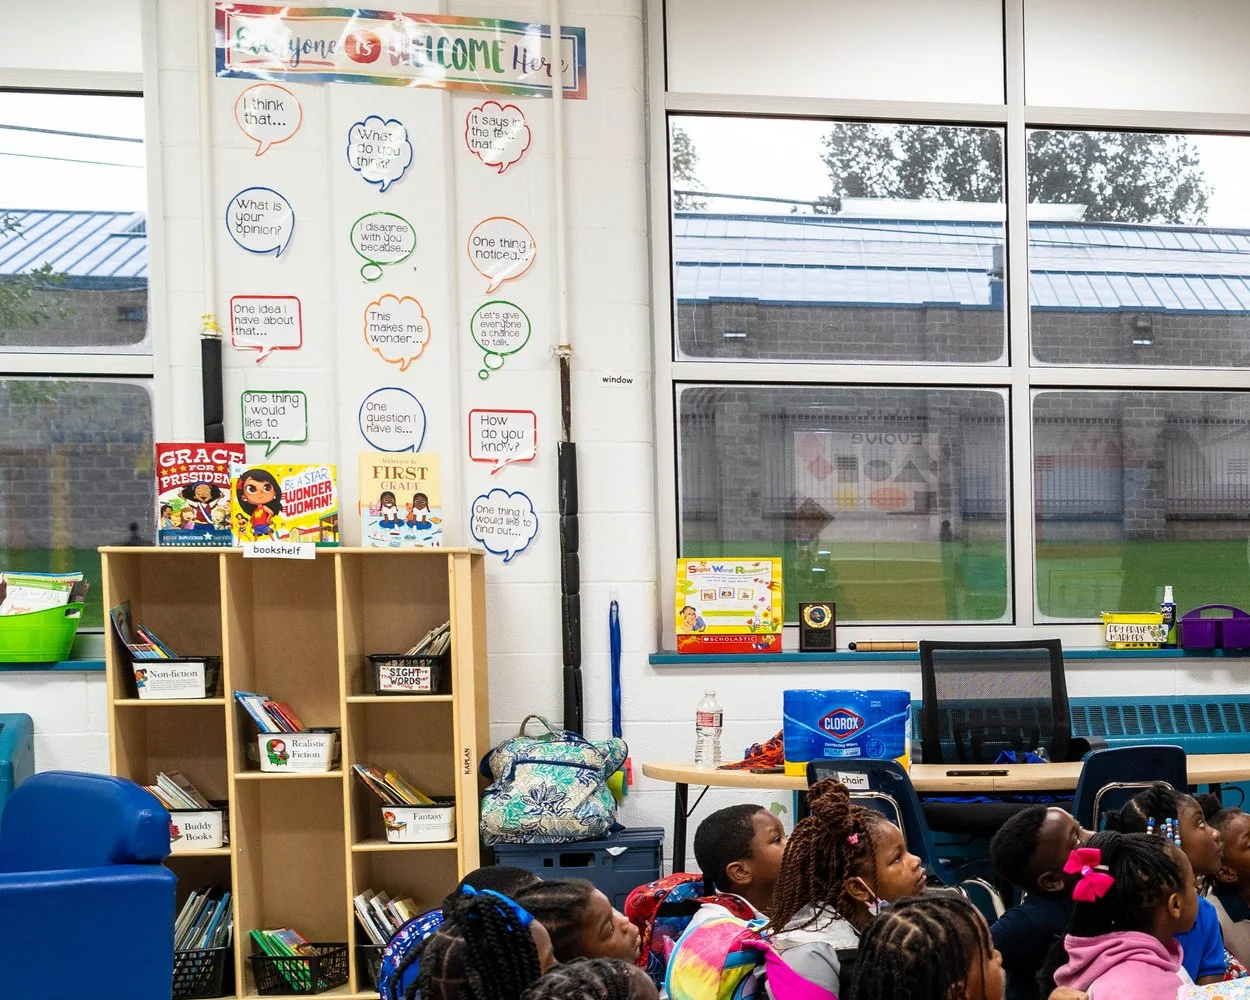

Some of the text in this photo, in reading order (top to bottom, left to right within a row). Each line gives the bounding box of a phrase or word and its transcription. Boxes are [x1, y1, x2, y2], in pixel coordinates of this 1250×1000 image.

[252, 98, 284, 111] think
[472, 114, 509, 129] It says
[358, 129, 392, 142] What
[472, 127, 489, 137] the
[357, 144, 400, 157] do you
[237, 199, 282, 211] What is
[236, 212, 264, 225] your
[236, 224, 281, 238] opinion?
[366, 223, 408, 235] disagree
[361, 233, 402, 246] with you
[473, 236, 526, 253] One thing
[234, 304, 281, 313] One idea
[235, 316, 293, 324] have about
[370, 312, 390, 321] This
[503, 312, 519, 322] give
[370, 324, 404, 332] makes
[481, 321, 521, 331] everyone
[236, 327, 267, 336] that...
[371, 334, 422, 343] wonder...
[602, 375, 633, 384] window
[244, 393, 299, 408] One thing
[251, 405, 285, 415] would
[366, 402, 387, 411] One
[245, 418, 278, 427] like to
[366, 414, 410, 425] question
[481, 415, 508, 425] How
[366, 424, 391, 433] have
[246, 429, 279, 439] add...
[482, 429, 524, 444] do you
[482, 442, 520, 452] know?
[160, 448, 244, 467] GRACE
[372, 466, 428, 480] FIRST
[161, 471, 231, 487] PRESIDEN
[285, 469, 329, 490] BE A STAR
[381, 482, 420, 490] GRADE
[285, 481, 332, 504] WONDER
[285, 494, 333, 516] WOMAN!
[476, 505, 519, 520] One thing
[476, 516, 503, 525] would
[506, 518, 520, 526] like
[476, 526, 494, 534] find
[254, 546, 301, 555] bookshelf
[712, 565, 733, 573] Word
[736, 566, 769, 574] Readers
[1109, 625, 1123, 633] DRY
[150, 669, 198, 679] Non-fiction
[390, 668, 420, 676] SIGHT
[825, 718, 859, 729] CLOROX
[292, 740, 326, 748] Realistic
[292, 750, 320, 759] Fiction
[413, 812, 443, 821] Fantasy
[184, 822, 212, 832] Buddy
[185, 832, 212, 841] Books
